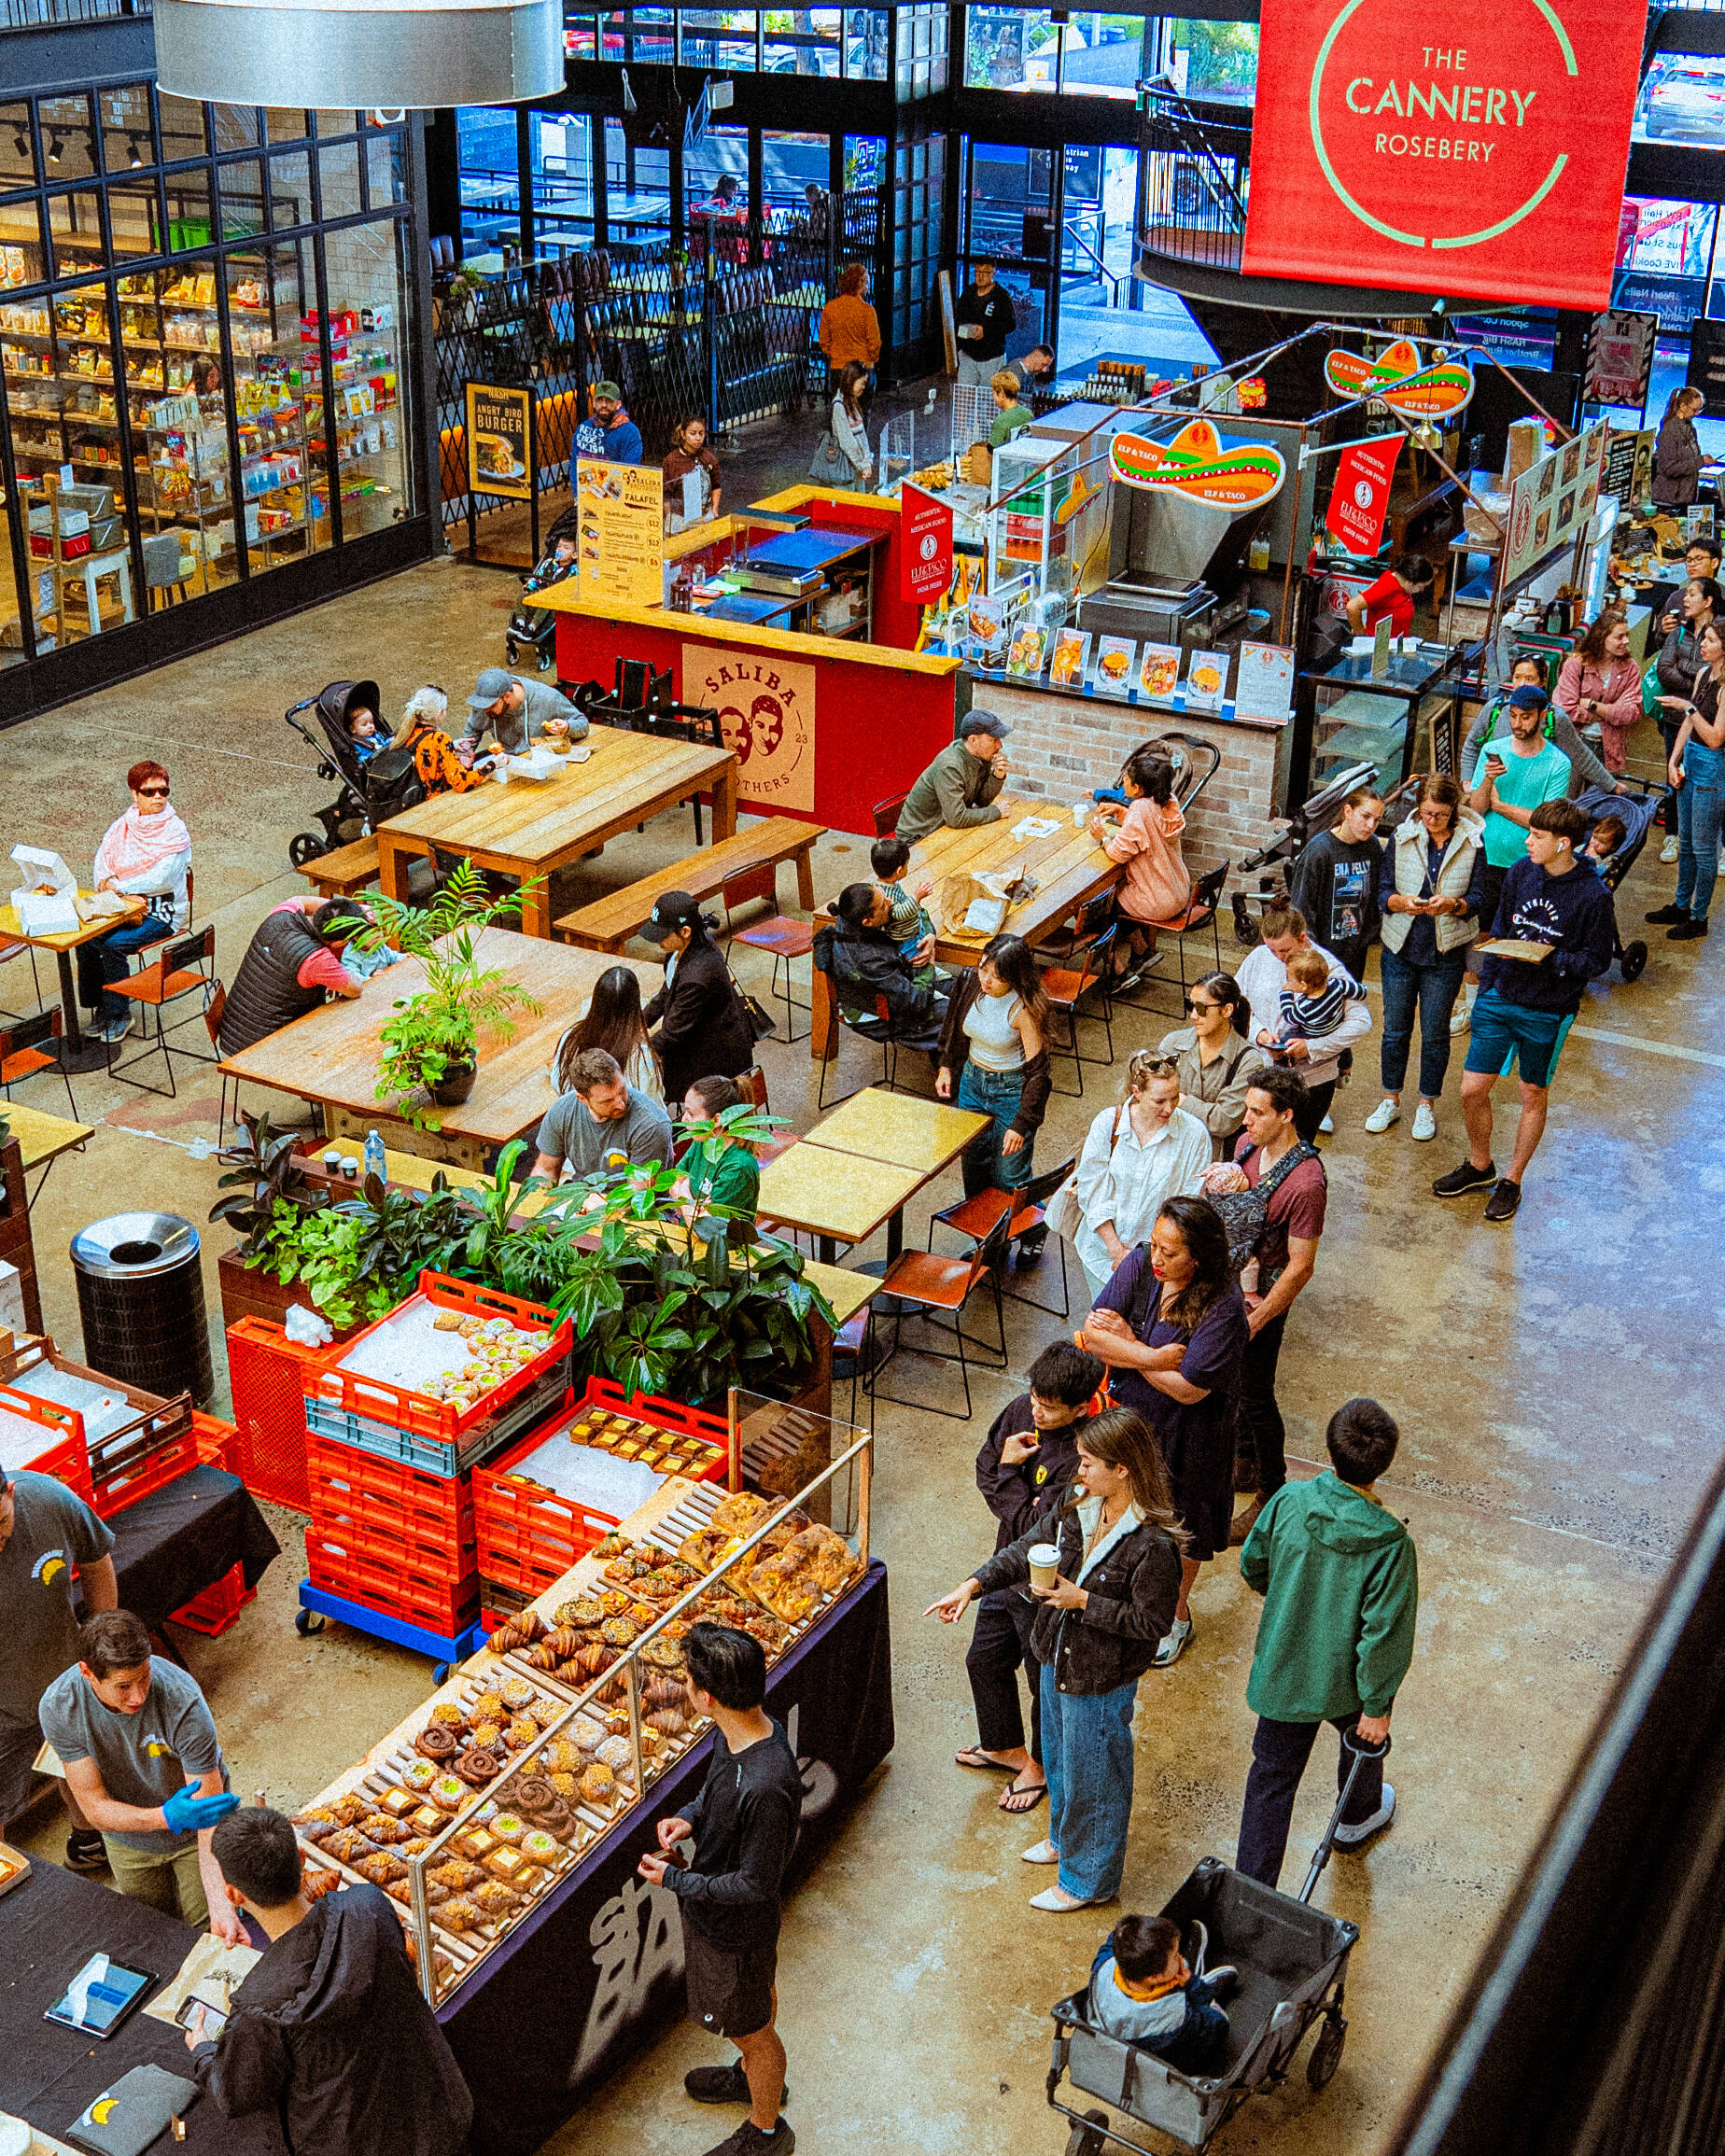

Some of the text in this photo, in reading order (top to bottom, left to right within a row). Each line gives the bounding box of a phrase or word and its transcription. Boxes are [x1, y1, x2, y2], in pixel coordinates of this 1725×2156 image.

[1423, 47, 1467, 71] THE
[1345, 77, 1536, 127] CANNERY
[1375, 133, 1495, 163] ROSEBERY
[1350, 366, 1367, 376] TACO
[477, 404, 500, 416] ANGRY
[477, 414, 523, 433] BURGER
[1117, 444, 1131, 455] ELF
[1139, 450, 1158, 462] TACO
[624, 493, 659, 505] FALAFEL
[1203, 489, 1246, 500] ELF & TACO
[705, 663, 797, 707] SALIBA
[795, 733, 808, 745] 23
